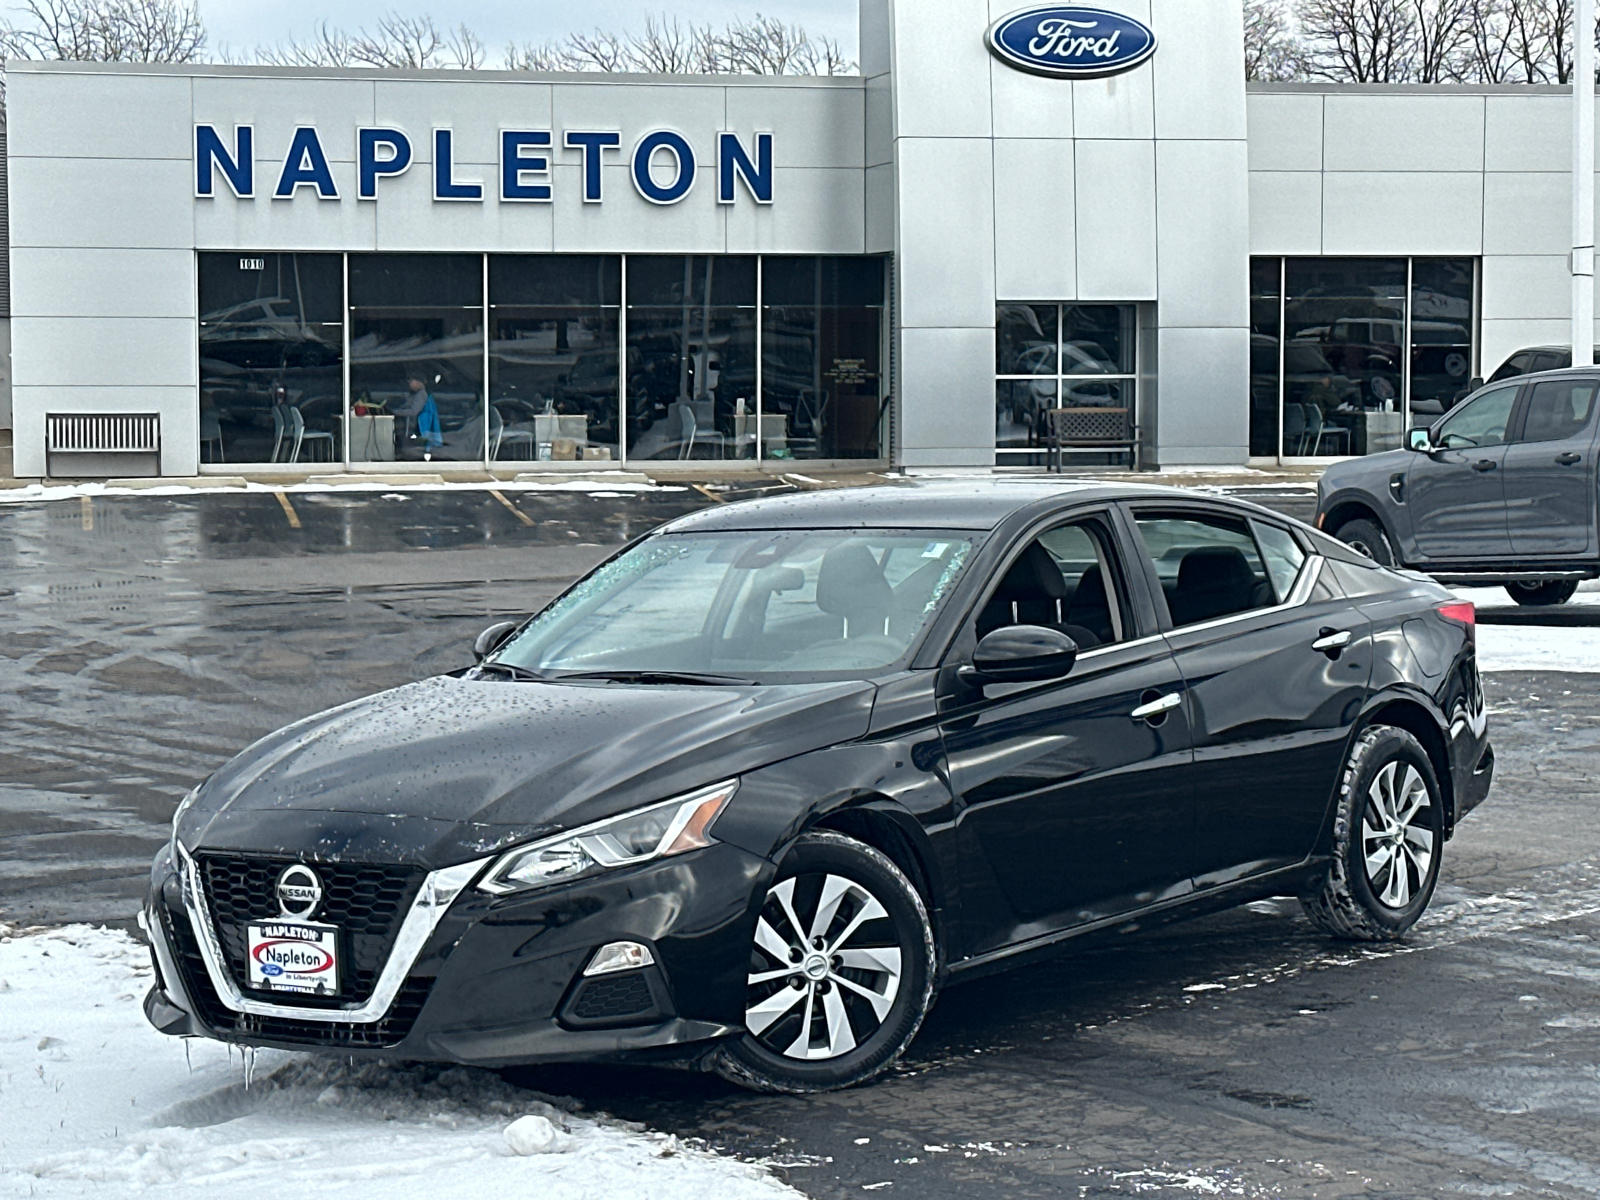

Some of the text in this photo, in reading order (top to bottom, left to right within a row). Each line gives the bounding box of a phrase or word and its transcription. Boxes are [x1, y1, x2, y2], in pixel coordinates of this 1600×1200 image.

[1028, 18, 1121, 57] Ford
[194, 123, 774, 206] NAPLETON
[241, 259, 263, 269] 1010
[279, 887, 316, 899] NISSAN
[265, 926, 316, 940] NAPLETON
[266, 946, 320, 967] Napleton
